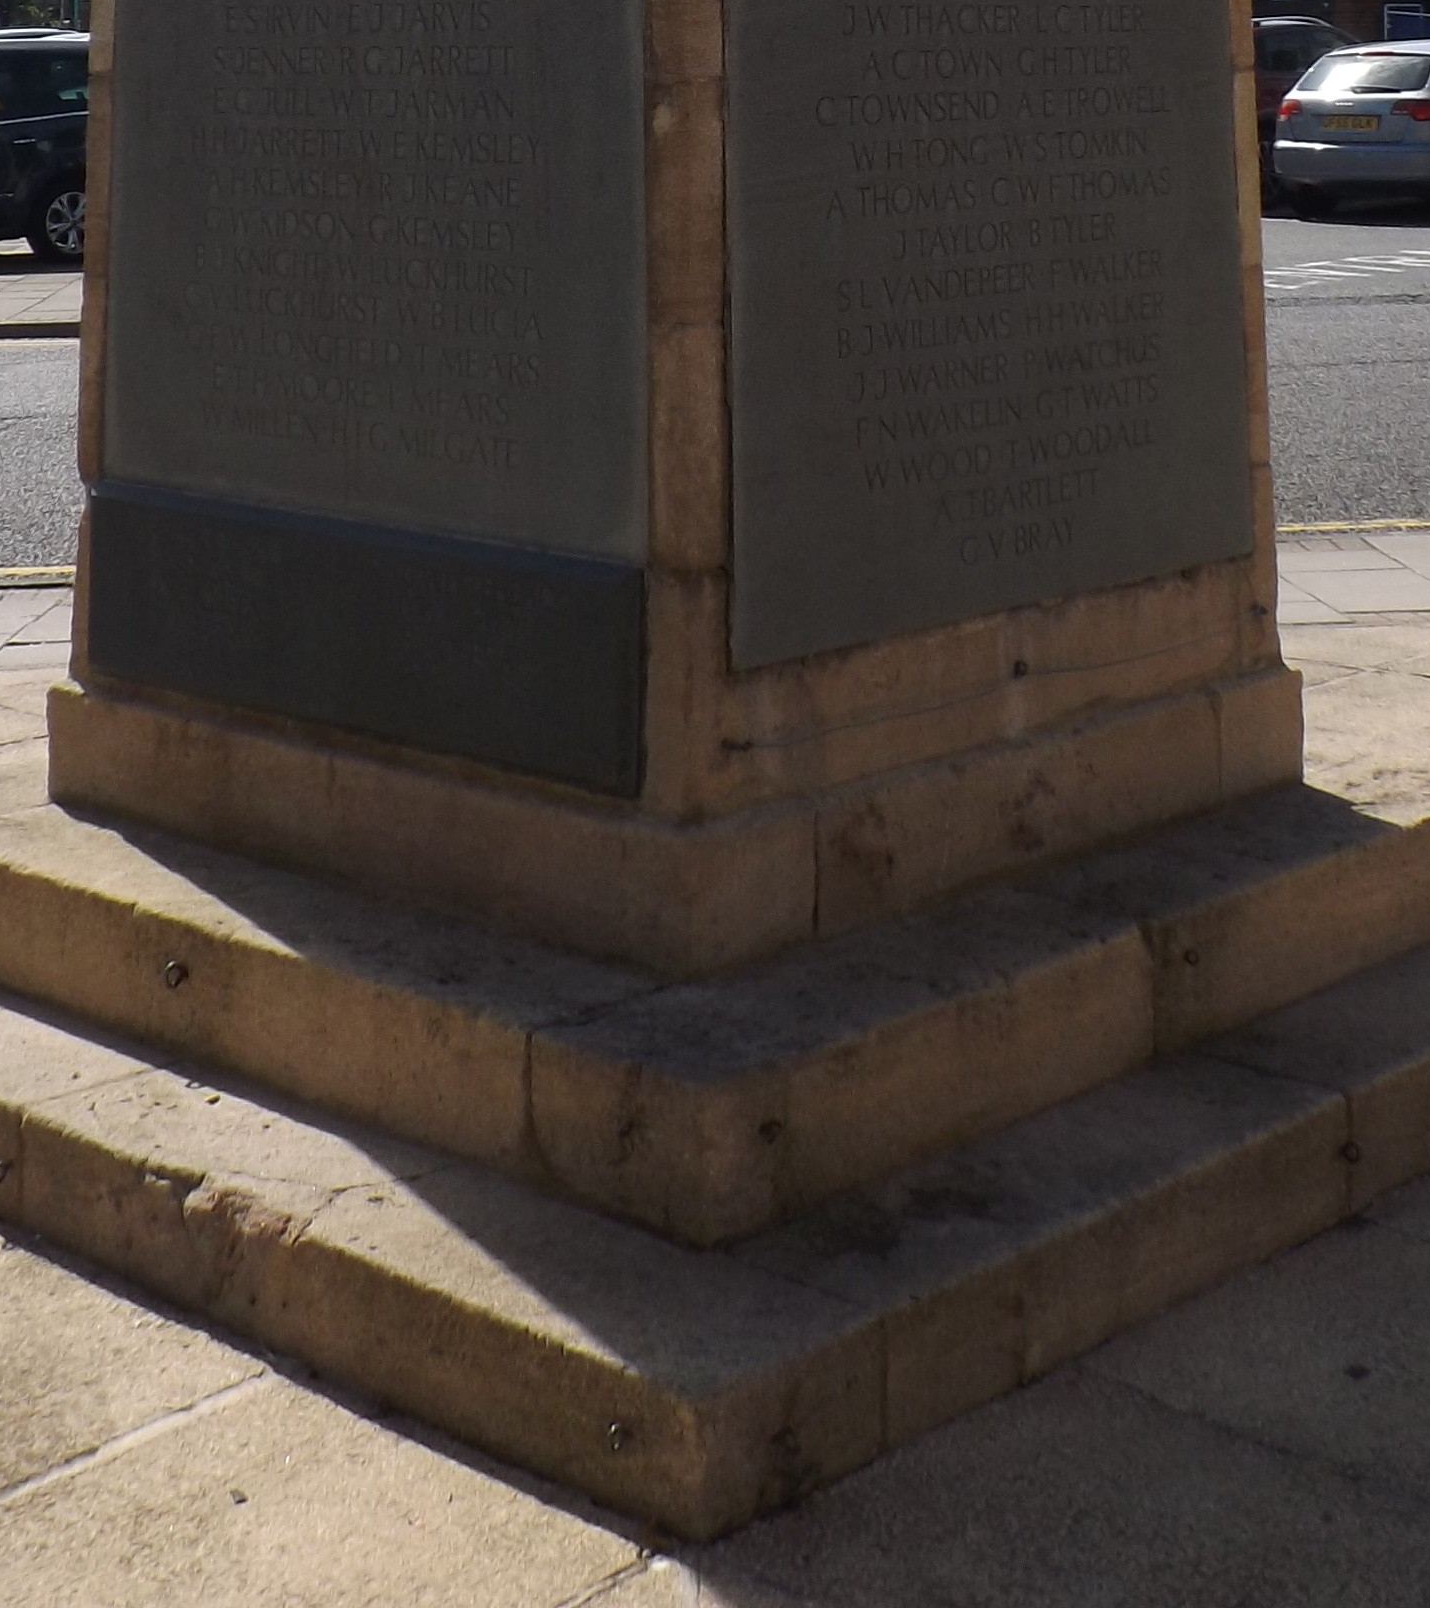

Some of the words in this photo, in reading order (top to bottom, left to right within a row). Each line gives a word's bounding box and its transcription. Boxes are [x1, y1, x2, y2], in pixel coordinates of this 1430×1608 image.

[392, 0, 492, 34] JARVIS
[900, 4, 1020, 34] THACKER
[1079, 4, 1146, 33] TYLER
[233, 47, 326, 75] JENNER
[390, 46, 513, 76] JARRETT
[920, 48, 1003, 79] TOWN
[1064, 46, 1131, 75] TYLER
[386, 88, 516, 121] JARMAN
[846, 91, 1000, 126] TOWNSEND
[1064, 86, 1172, 116] TROWELL
[233, 126, 345, 158] JARRETT
[415, 130, 541, 166] KEMSLEY
[912, 135, 989, 167] TONG
[1053, 127, 1147, 160] TOMKIN
[253, 168, 362, 199] KEMSLEY
[425, 173, 520, 209] KEANE
[856, 180, 977, 217] THOMAS
[1069, 166, 1172, 201] THOMAS
[396, 216, 519, 251] KEMSLEY
[916, 221, 1012, 254] TAYLOR
[1050, 213, 1116, 242] TYLER
[233, 247, 322, 280] KNIGHT
[371, 254, 533, 294] LUCKHURST
[881, 262, 1035, 306] VANDEPEER
[1069, 249, 1163, 286] WALKER
[882, 308, 1011, 351] WILLIAMS
[1072, 293, 1164, 327] WALKER
[278, 373, 373, 407] MOORE
[897, 353, 1008, 394] WARNER
[906, 397, 1022, 441] WAKELIN
[1081, 374, 1158, 411] WATTS
[900, 444, 992, 484] WOOD
[1029, 419, 1156, 464] WOODALL
[983, 467, 1099, 518] BARTLETT
[1015, 517, 1073, 557] BRAY
